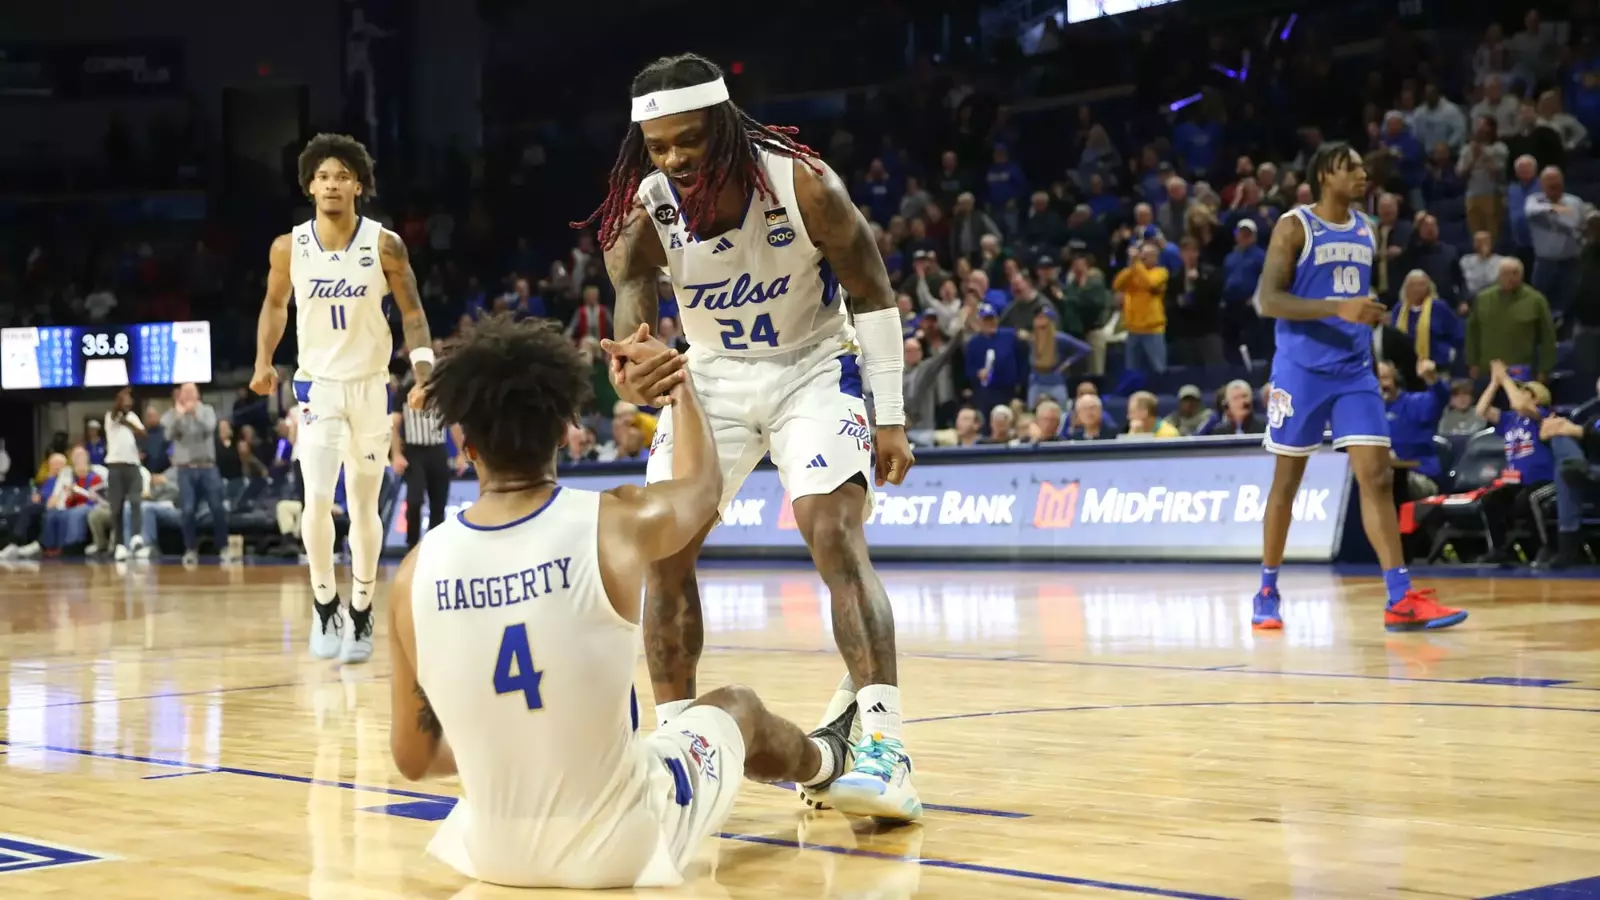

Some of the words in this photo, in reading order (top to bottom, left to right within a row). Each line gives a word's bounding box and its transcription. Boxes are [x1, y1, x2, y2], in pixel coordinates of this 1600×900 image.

[658, 208, 675, 221] 32
[769, 231, 793, 243] DOC
[308, 278, 368, 299] Tulsa
[683, 272, 791, 310] Tulsa
[1333, 266, 1360, 294] 10
[330, 304, 346, 330] 11
[714, 312, 780, 350] 24
[938, 490, 1017, 525] BANK
[435, 557, 571, 611] HAGGERTY
[493, 623, 543, 710] 4
